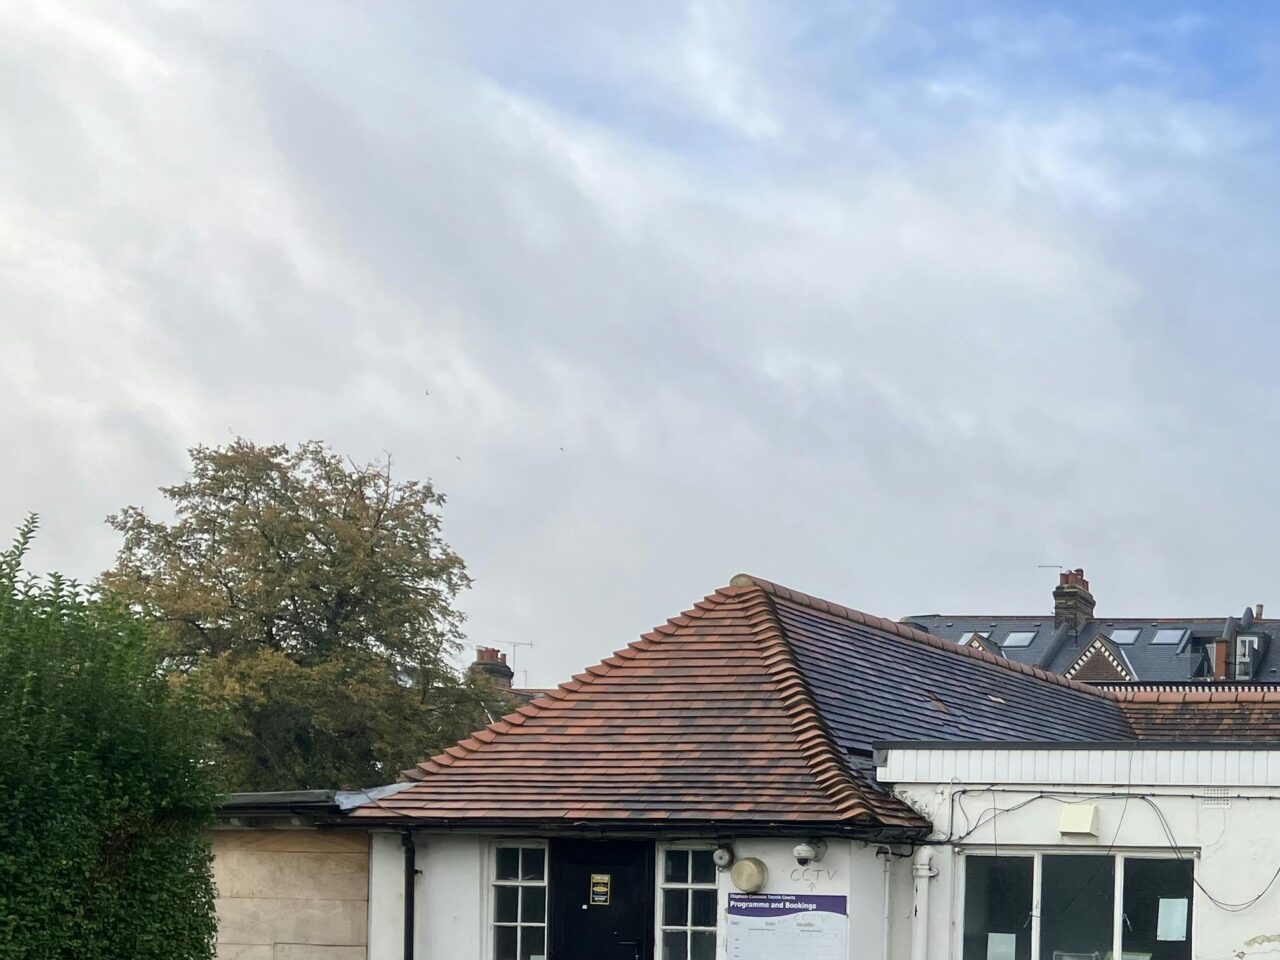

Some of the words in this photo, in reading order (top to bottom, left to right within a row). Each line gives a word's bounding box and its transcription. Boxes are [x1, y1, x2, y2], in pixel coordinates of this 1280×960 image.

[790, 868, 838, 881] CCTV
[729, 900, 770, 909] Programme
[770, 901, 784, 909] and
[785, 902, 817, 910] Bookings
